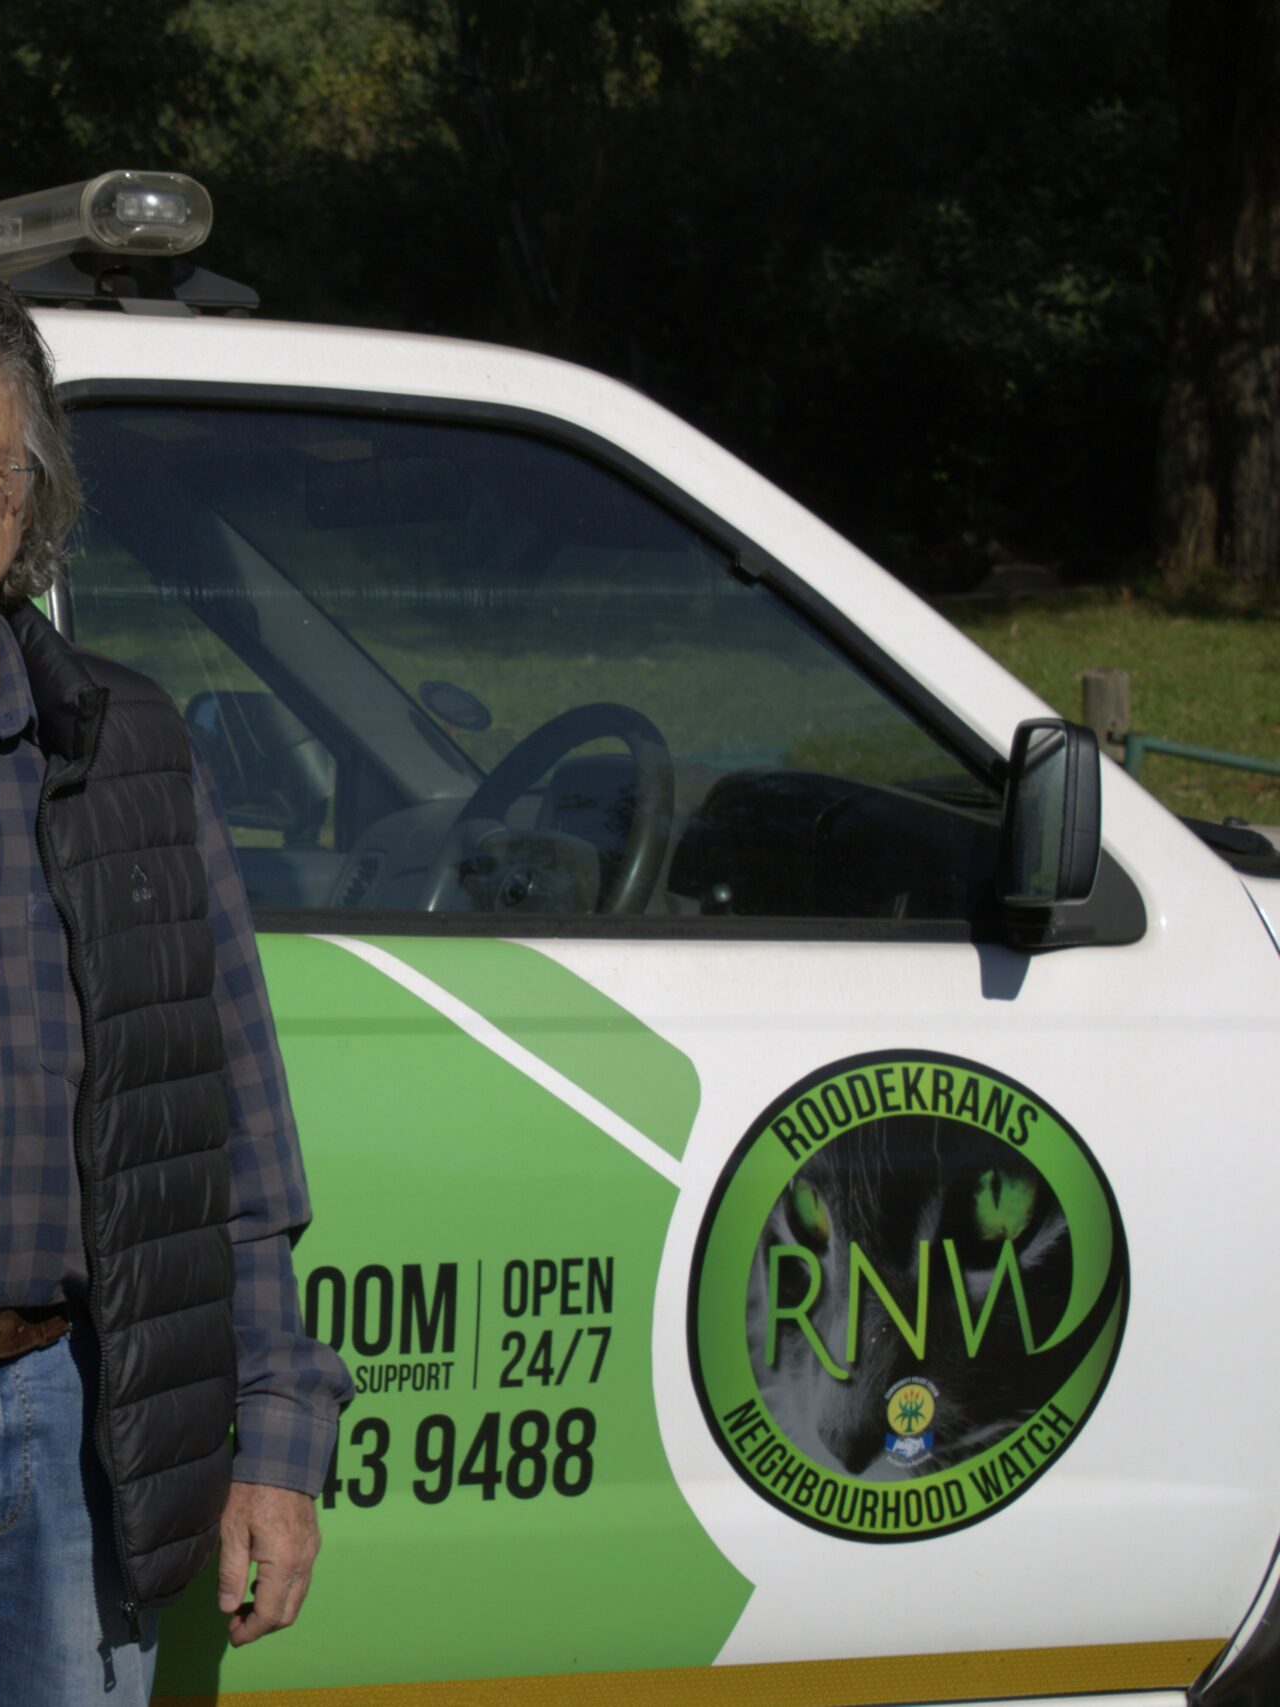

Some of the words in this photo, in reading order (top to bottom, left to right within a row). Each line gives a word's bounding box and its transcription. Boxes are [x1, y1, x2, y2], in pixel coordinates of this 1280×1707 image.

[770, 1065, 1039, 1161] ROODEKRANS
[502, 1256, 615, 1318] OPEN
[764, 1239, 1037, 1380] RNW
[355, 1362, 455, 1394] SUPPORT
[499, 1326, 612, 1389] 24/7
[412, 1407, 597, 1505] 9488
[722, 1398, 968, 1529] NEIGHBOURHOOD
[968, 1402, 1076, 1504] WATCH
